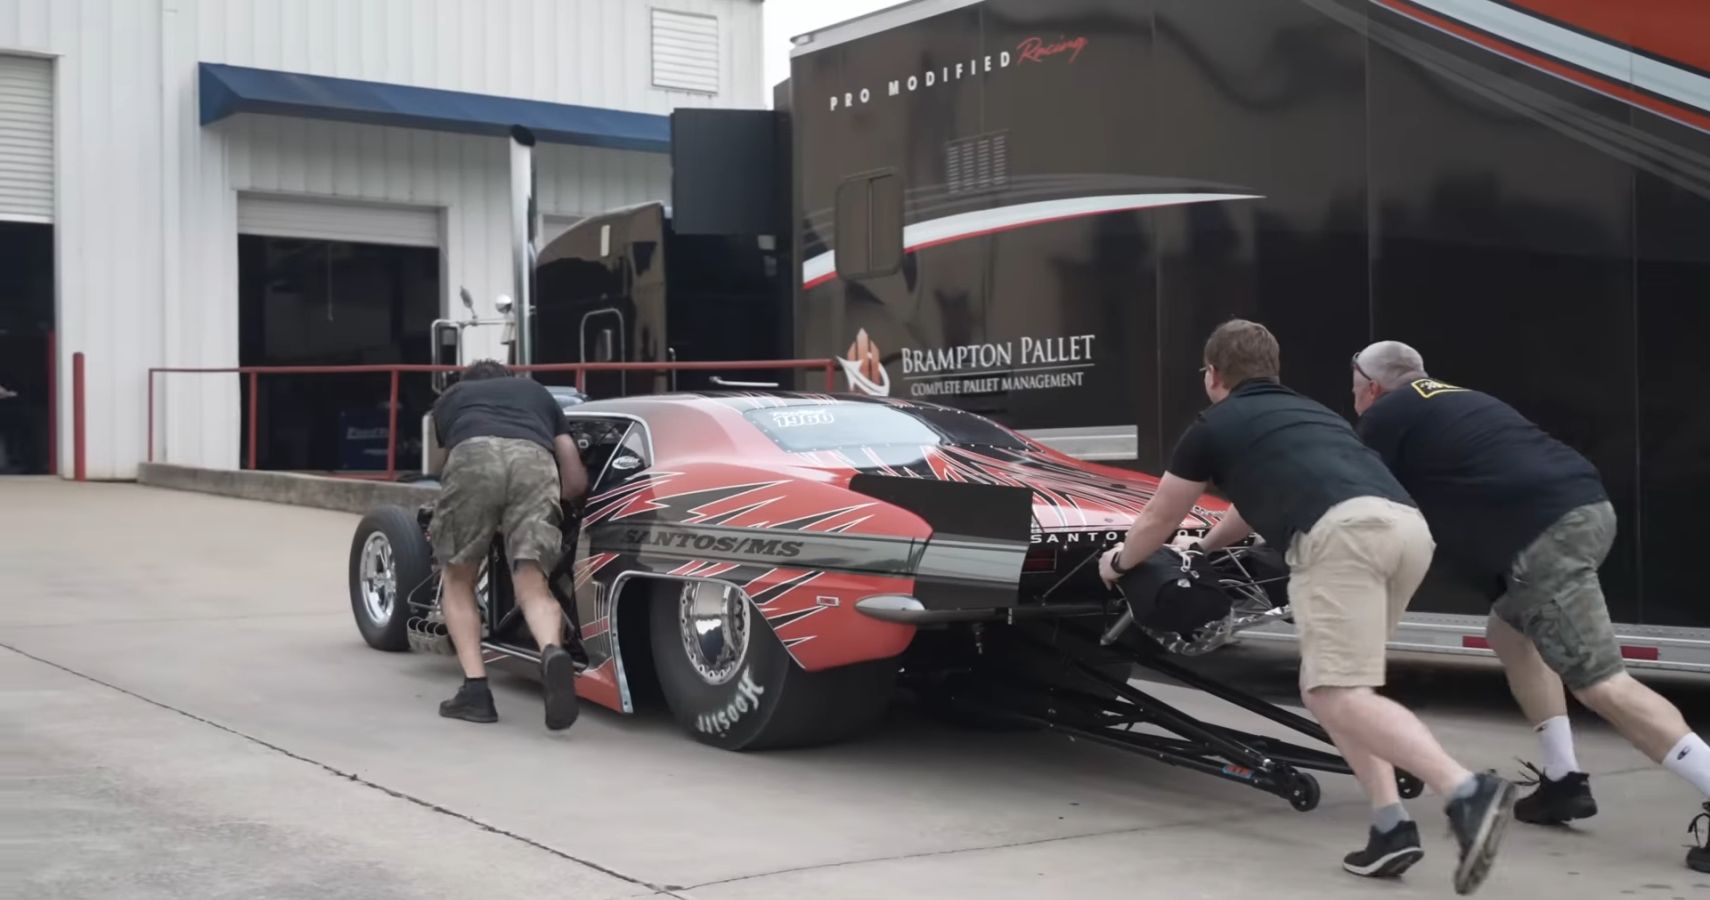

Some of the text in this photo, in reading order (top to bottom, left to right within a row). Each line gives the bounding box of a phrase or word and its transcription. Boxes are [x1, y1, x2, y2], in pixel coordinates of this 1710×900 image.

[829, 35, 1088, 111] PRO MODIFIED Racing
[901, 334, 1096, 374] BRAMPTON PALLET
[910, 371, 1085, 397] COMPLETE PALLET MANAGEMENT
[623, 528, 804, 558] SANTOS/MS
[1029, 530, 1129, 544] SANTO
